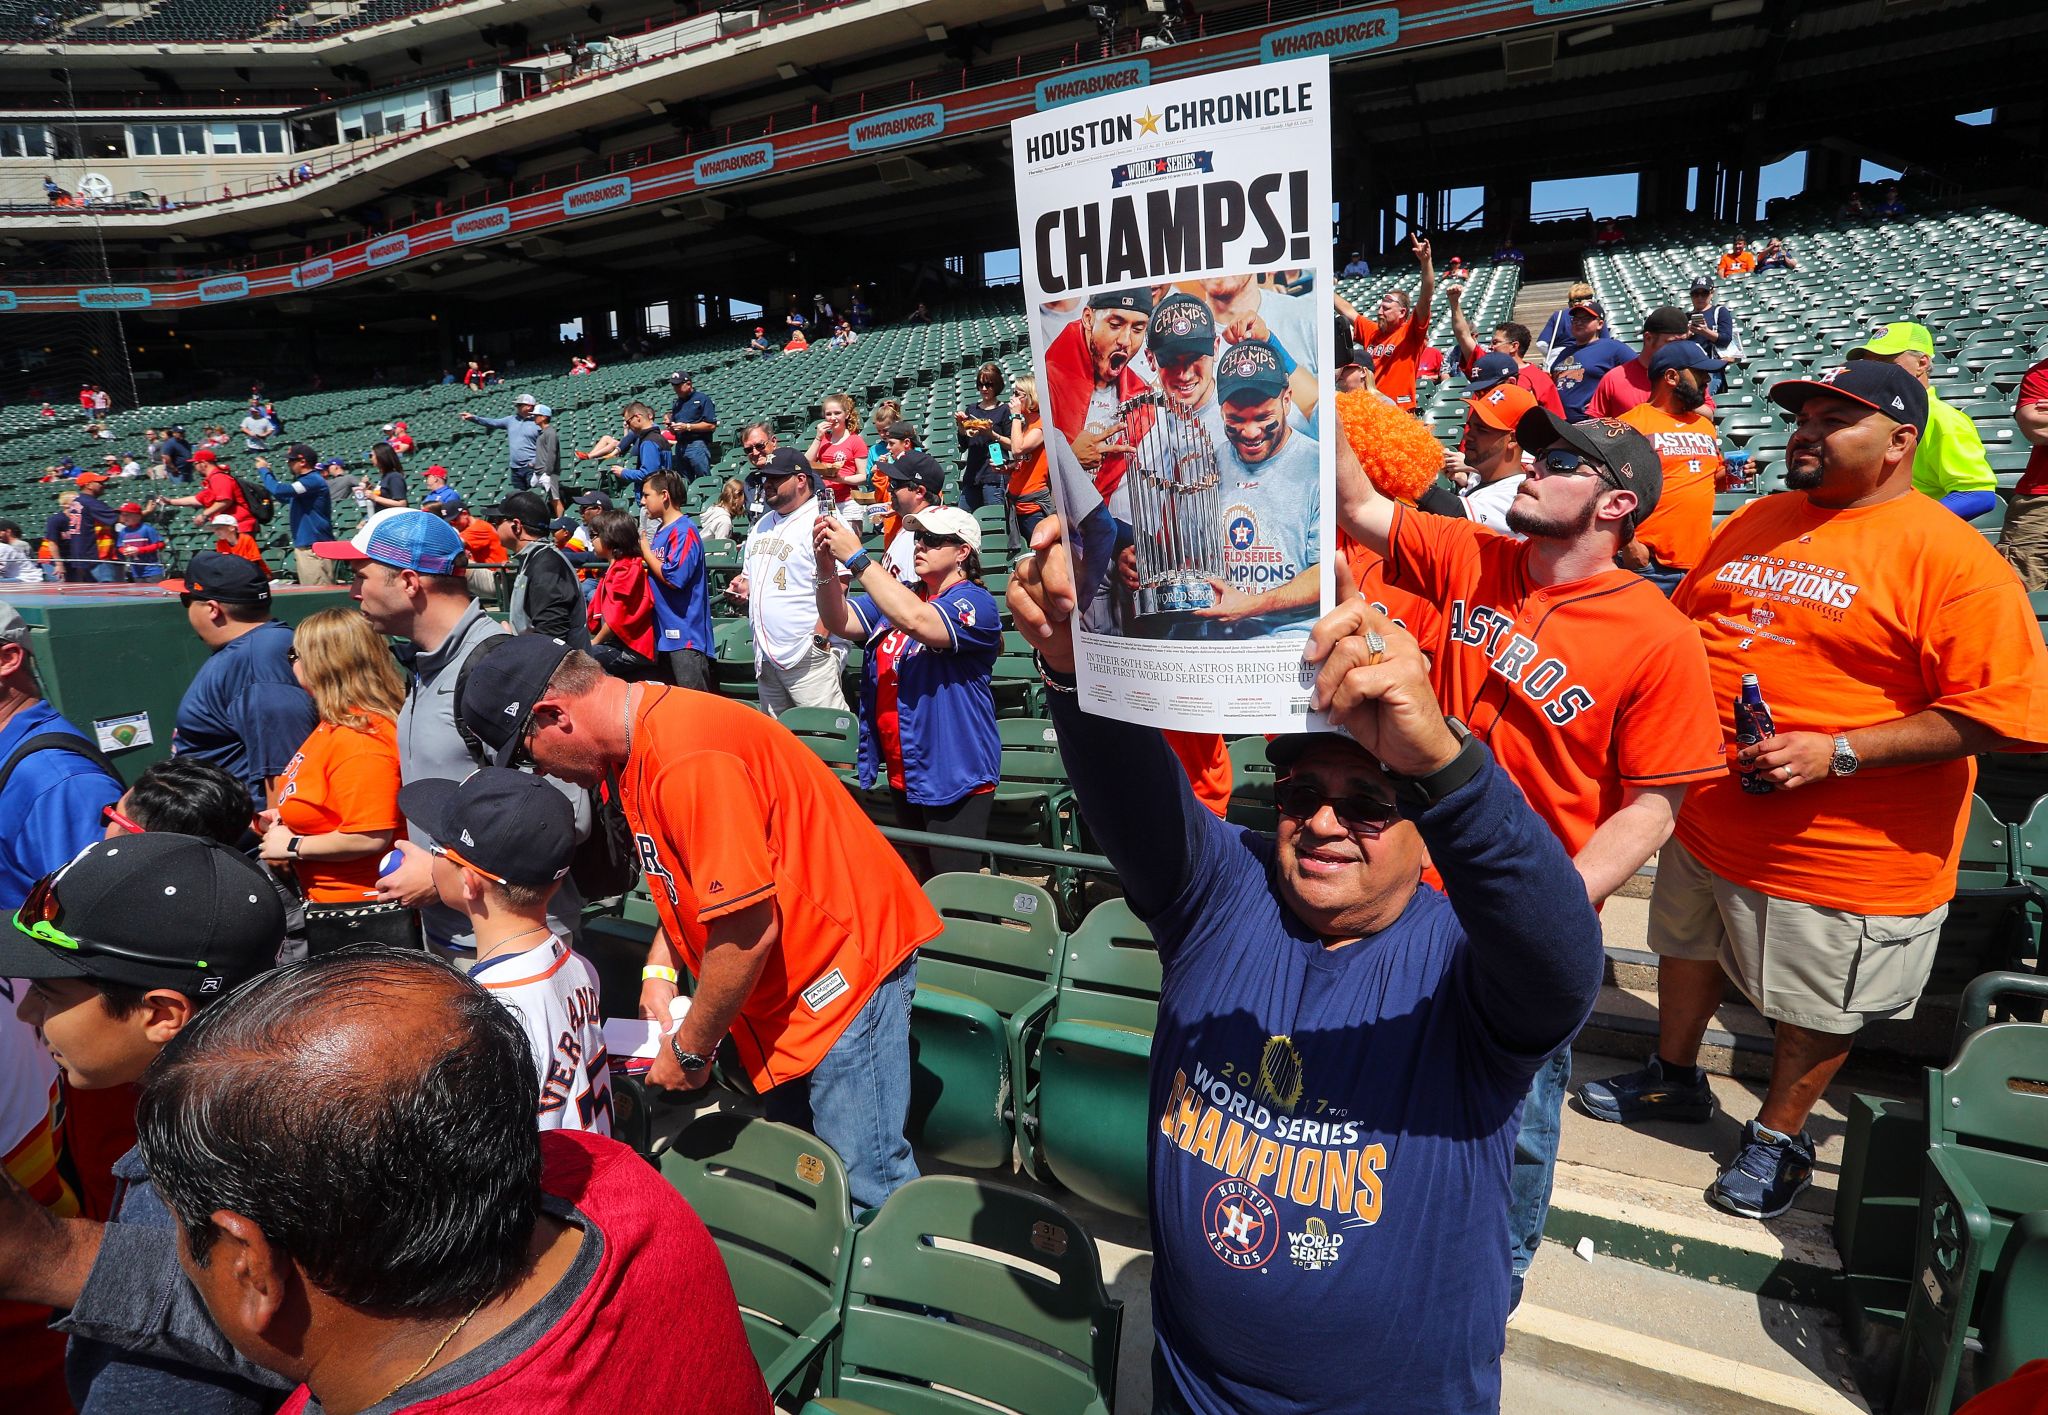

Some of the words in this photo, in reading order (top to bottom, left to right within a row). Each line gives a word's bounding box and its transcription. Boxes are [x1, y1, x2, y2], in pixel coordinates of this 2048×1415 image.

[1271, 19, 1390, 57] WHATABURGER
[1044, 68, 1143, 103] WHATABURGER
[856, 111, 938, 143] WHATABURGER
[1026, 114, 1133, 163] HOUSTON
[1165, 82, 1313, 132] CHRONICLE
[700, 150, 768, 177] WHATABURGER
[1127, 160, 1157, 179] WORLD
[1166, 153, 1196, 169] SERIES
[569, 184, 627, 208] WHATABURGER
[456, 214, 505, 236] WHATABURGER
[1035, 170, 1310, 294] CHAMPS!
[1154, 308, 1208, 333] CHAMPS
[1158, 303, 1180, 319] WORLD
[1181, 302, 1202, 311] SERIES
[1221, 351, 1276, 374] CHAMPS
[1226, 346, 1248, 359] WORLD
[1249, 346, 1272, 356] SERIES
[1654, 432, 1715, 449] ASTROS
[1663, 447, 1706, 456] BASEBALL
[1224, 551, 1242, 563] RLD
[1245, 552, 1283, 563] SERIES
[1742, 554, 1785, 566] WORLD
[1788, 560, 1847, 579] SERIES
[773, 566, 786, 590] 4
[1226, 564, 1295, 583] MPIONS
[1715, 561, 1860, 609] CHAMPIONS
[1751, 608, 1775, 619] WORLD
[1086, 652, 1095, 662] IN
[1095, 654, 1120, 666] THEIR
[1121, 658, 1141, 669] 56TH
[1143, 661, 1186, 673] SEASON,
[1188, 663, 1234, 673] ASTROS
[1237, 663, 1275, 673] BRING
[1278, 661, 1316, 672] HOME
[1088, 662, 1112, 675] THEIR
[1112, 667, 1136, 678] FIRST
[1136, 670, 1173, 682] WORLD
[1175, 673, 1214, 684] SERIES
[1216, 672, 1314, 684] CHAMPIONSHIP
[1451, 600, 1596, 727] ASTROS
[1221, 1062, 1251, 1088] 20
[1193, 1061, 1271, 1130] WORLD
[1275, 1115, 1360, 1145] SERIES
[1160, 1067, 1387, 1224] CHAMPIONS
[806, 1157, 816, 1168] 32
[1218, 1182, 1273, 1217] HOUSTON
[1043, 1225, 1055, 1236] 31
[1288, 1232, 1344, 1248] WORLD
[1209, 1231, 1261, 1265] ASTROS
[1290, 1247, 1339, 1261] SERIES
[1928, 1280, 1936, 1293] 2
